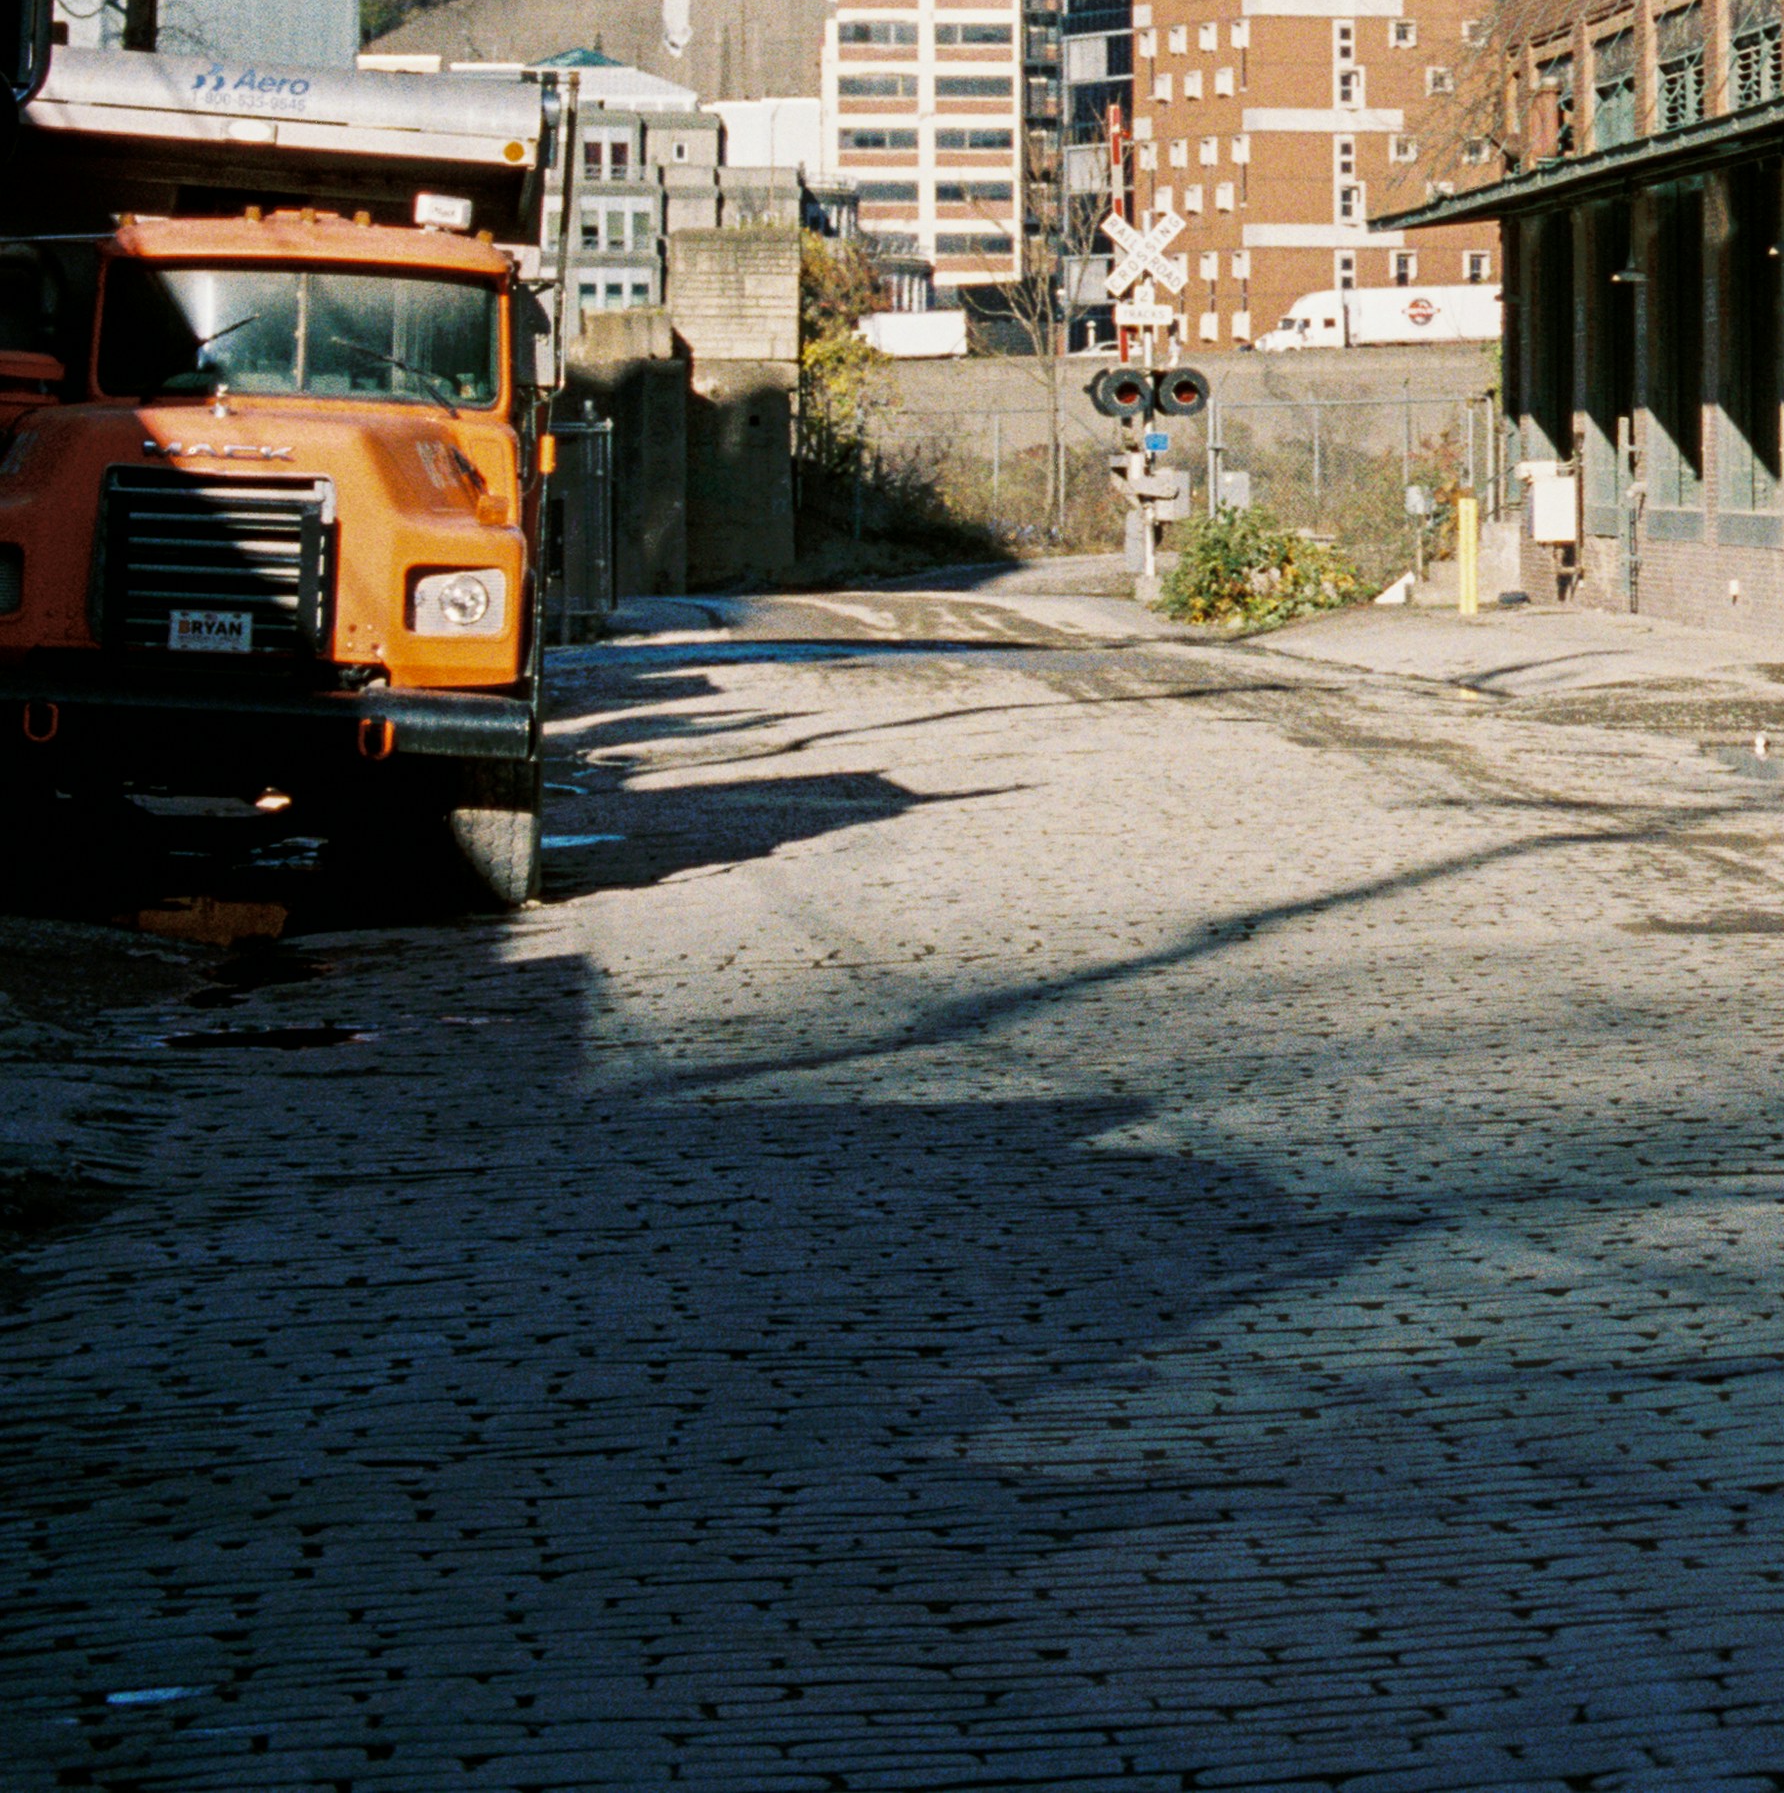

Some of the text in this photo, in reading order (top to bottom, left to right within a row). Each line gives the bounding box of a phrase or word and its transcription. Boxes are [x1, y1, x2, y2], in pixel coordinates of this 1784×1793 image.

[232, 68, 311, 96] Aero
[1110, 215, 1180, 290] CROSSING
[1139, 289, 1149, 303] 2
[1123, 309, 1166, 320] TRACKS
[143, 440, 296, 462] MACK
[178, 619, 243, 636] BRYAN
